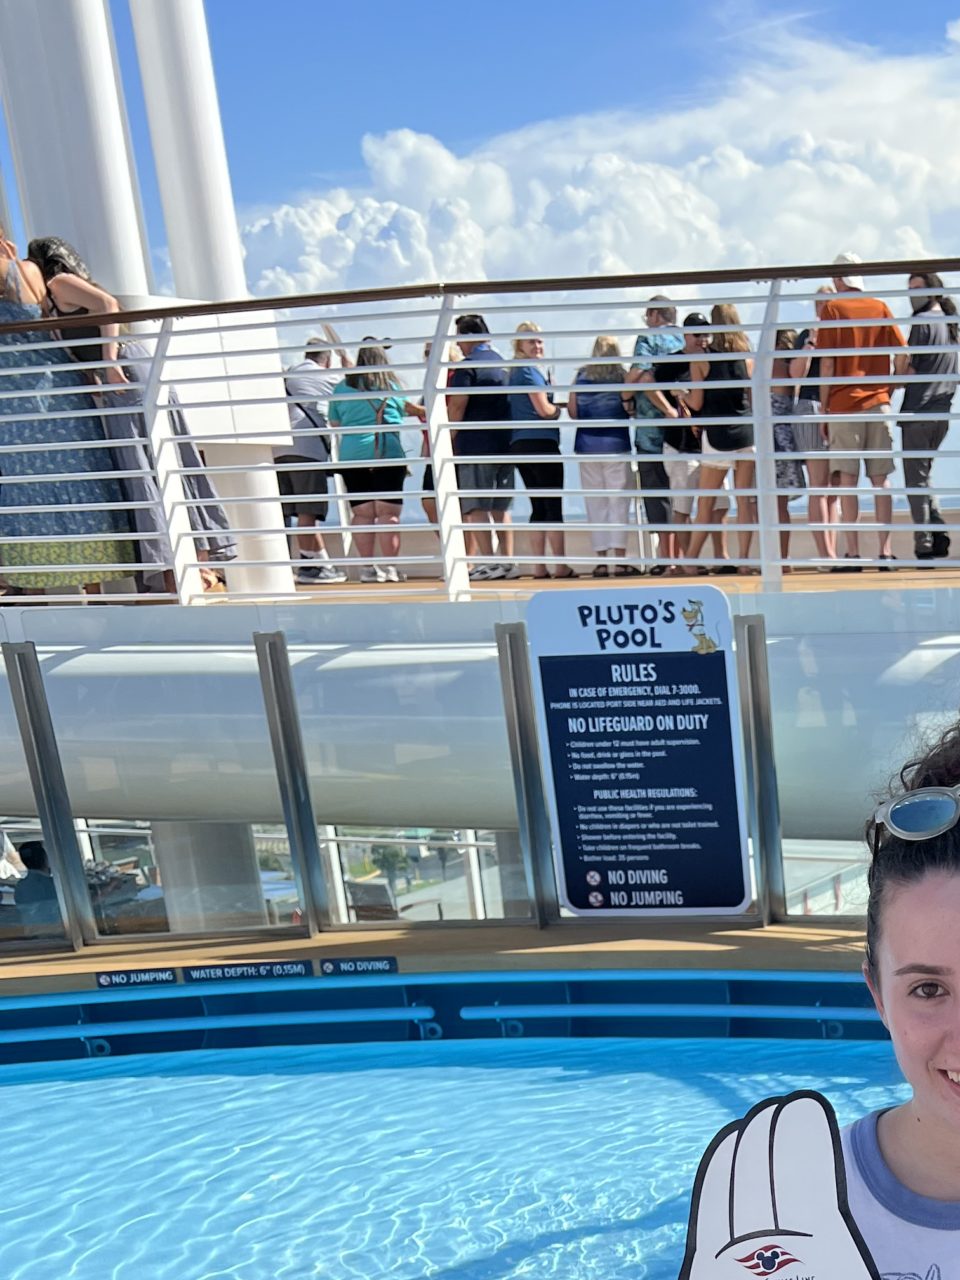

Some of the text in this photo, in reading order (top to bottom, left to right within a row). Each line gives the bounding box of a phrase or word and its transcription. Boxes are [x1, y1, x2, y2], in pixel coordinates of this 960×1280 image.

[577, 600, 676, 627] PLUTO'S
[596, 627, 662, 650] POOL
[611, 664, 657, 683] RULES
[569, 688, 578, 697] IN
[579, 688, 596, 697] CASE
[597, 687, 607, 696] OF
[608, 686, 653, 696] EMERGENCY,
[654, 686, 671, 695] DIAL
[568, 714, 709, 733] NO LIFEGUARD ON DUTY
[593, 788, 698, 799] PUBLIC HEALTH REGULATIONS:
[608, 870, 668, 885] NO DIVING
[610, 891, 683, 906] NO JUMPING
[191, 968, 222, 979] WATER
[225, 966, 258, 977] DEPTH:
[340, 961, 390, 971] NO DIVING
[112, 971, 173, 984] NO JUMPING
